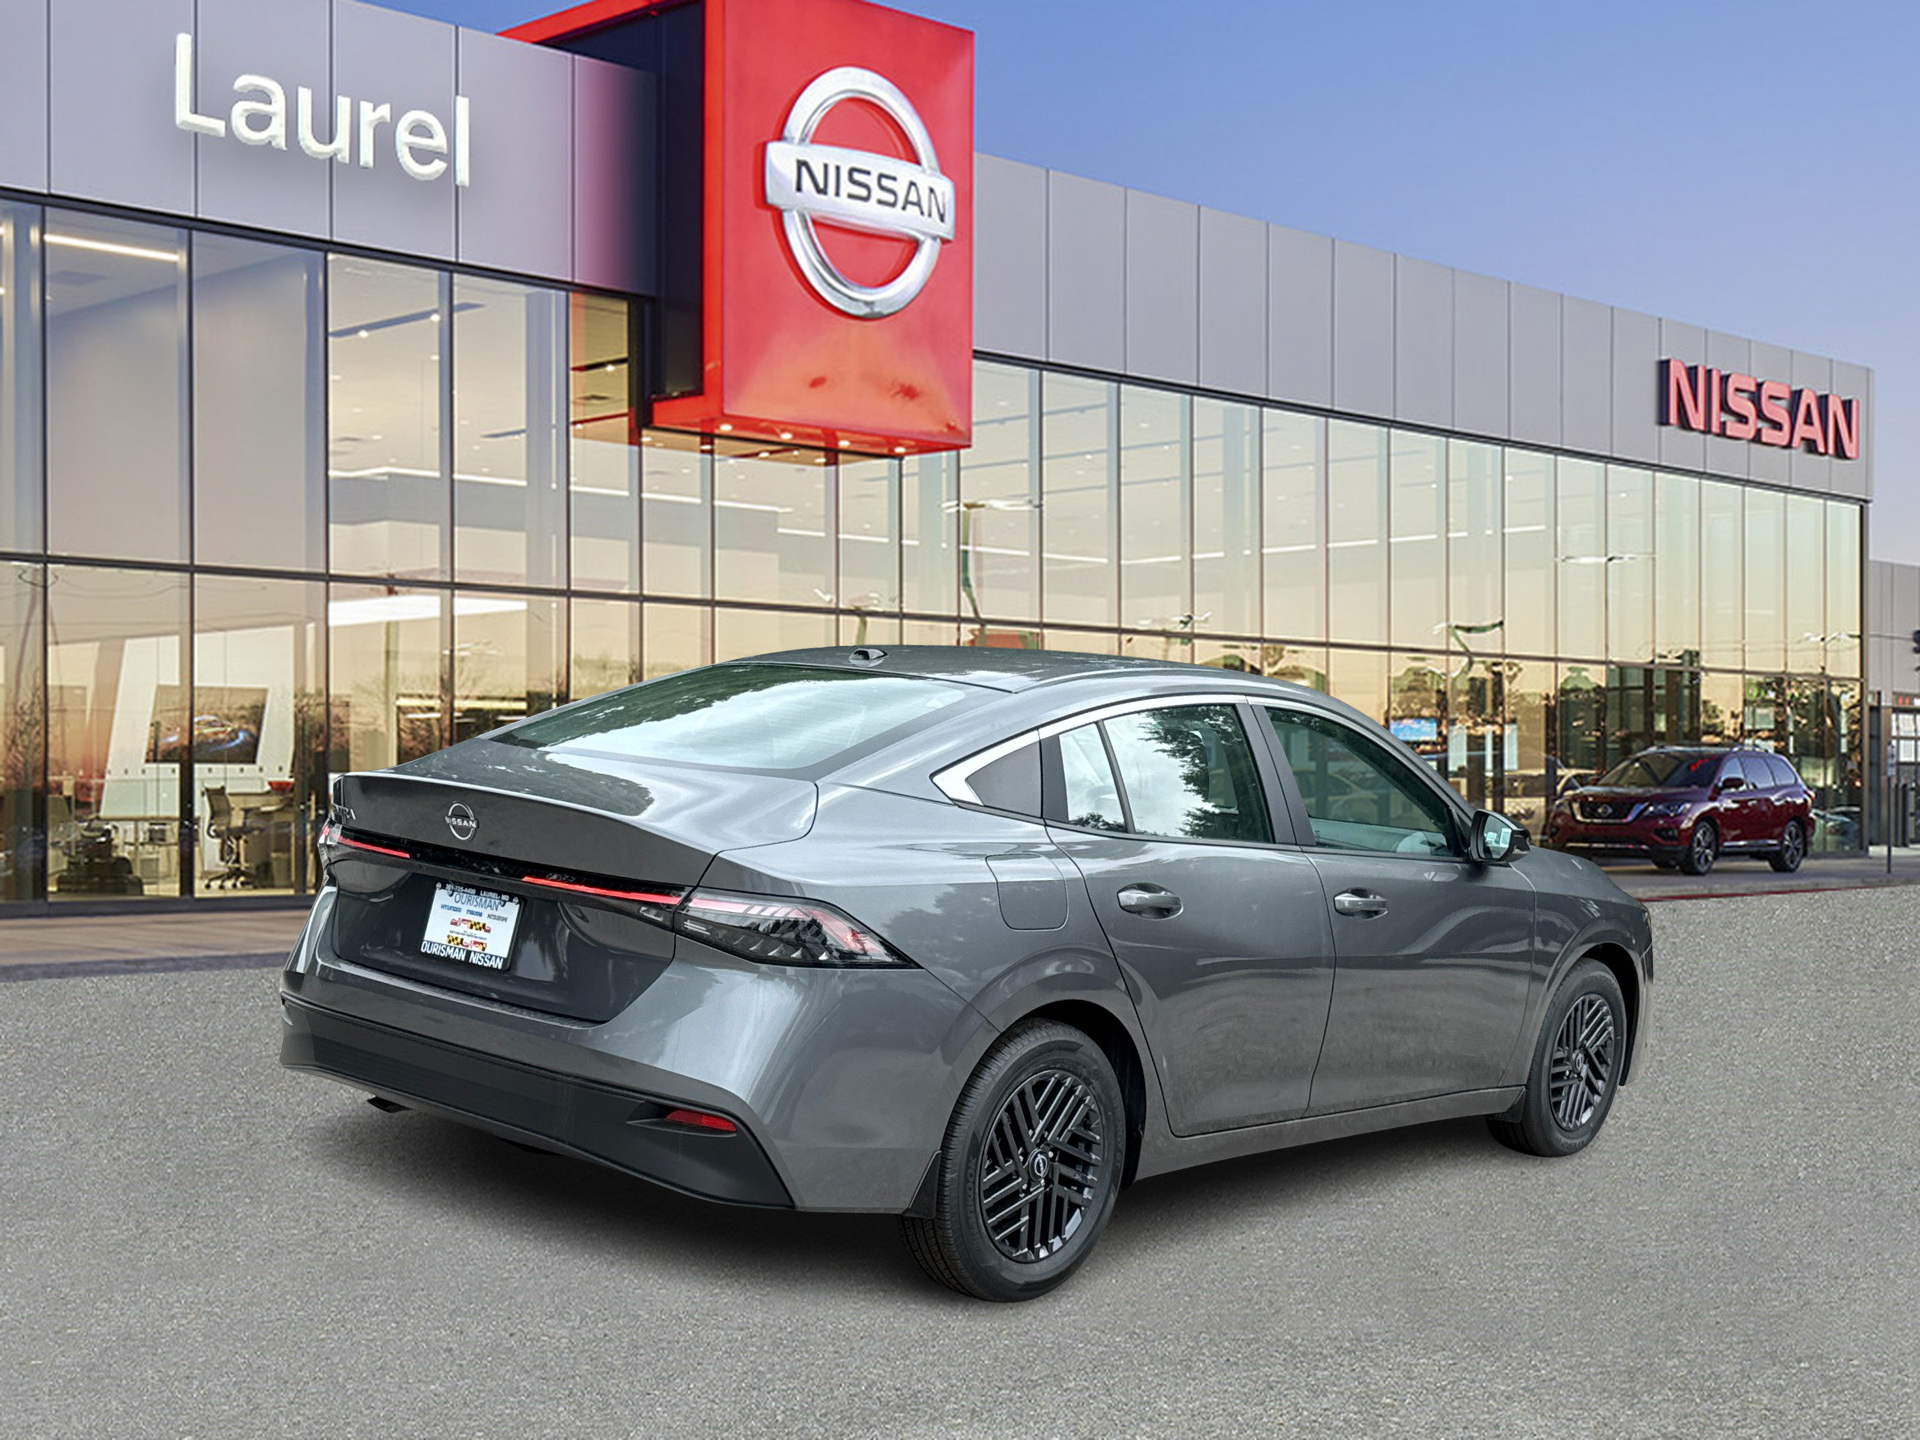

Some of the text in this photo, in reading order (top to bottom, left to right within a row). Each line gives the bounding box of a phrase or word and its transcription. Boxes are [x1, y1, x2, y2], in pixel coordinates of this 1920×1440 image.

[175, 33, 470, 187] Laurel
[795, 158, 946, 223] NISSAN
[1657, 357, 1859, 459] NISSAN
[445, 816, 477, 828] NISSAN
[454, 893, 499, 912] OURISMAN
[421, 940, 503, 969] OURISMAN NISSAN
